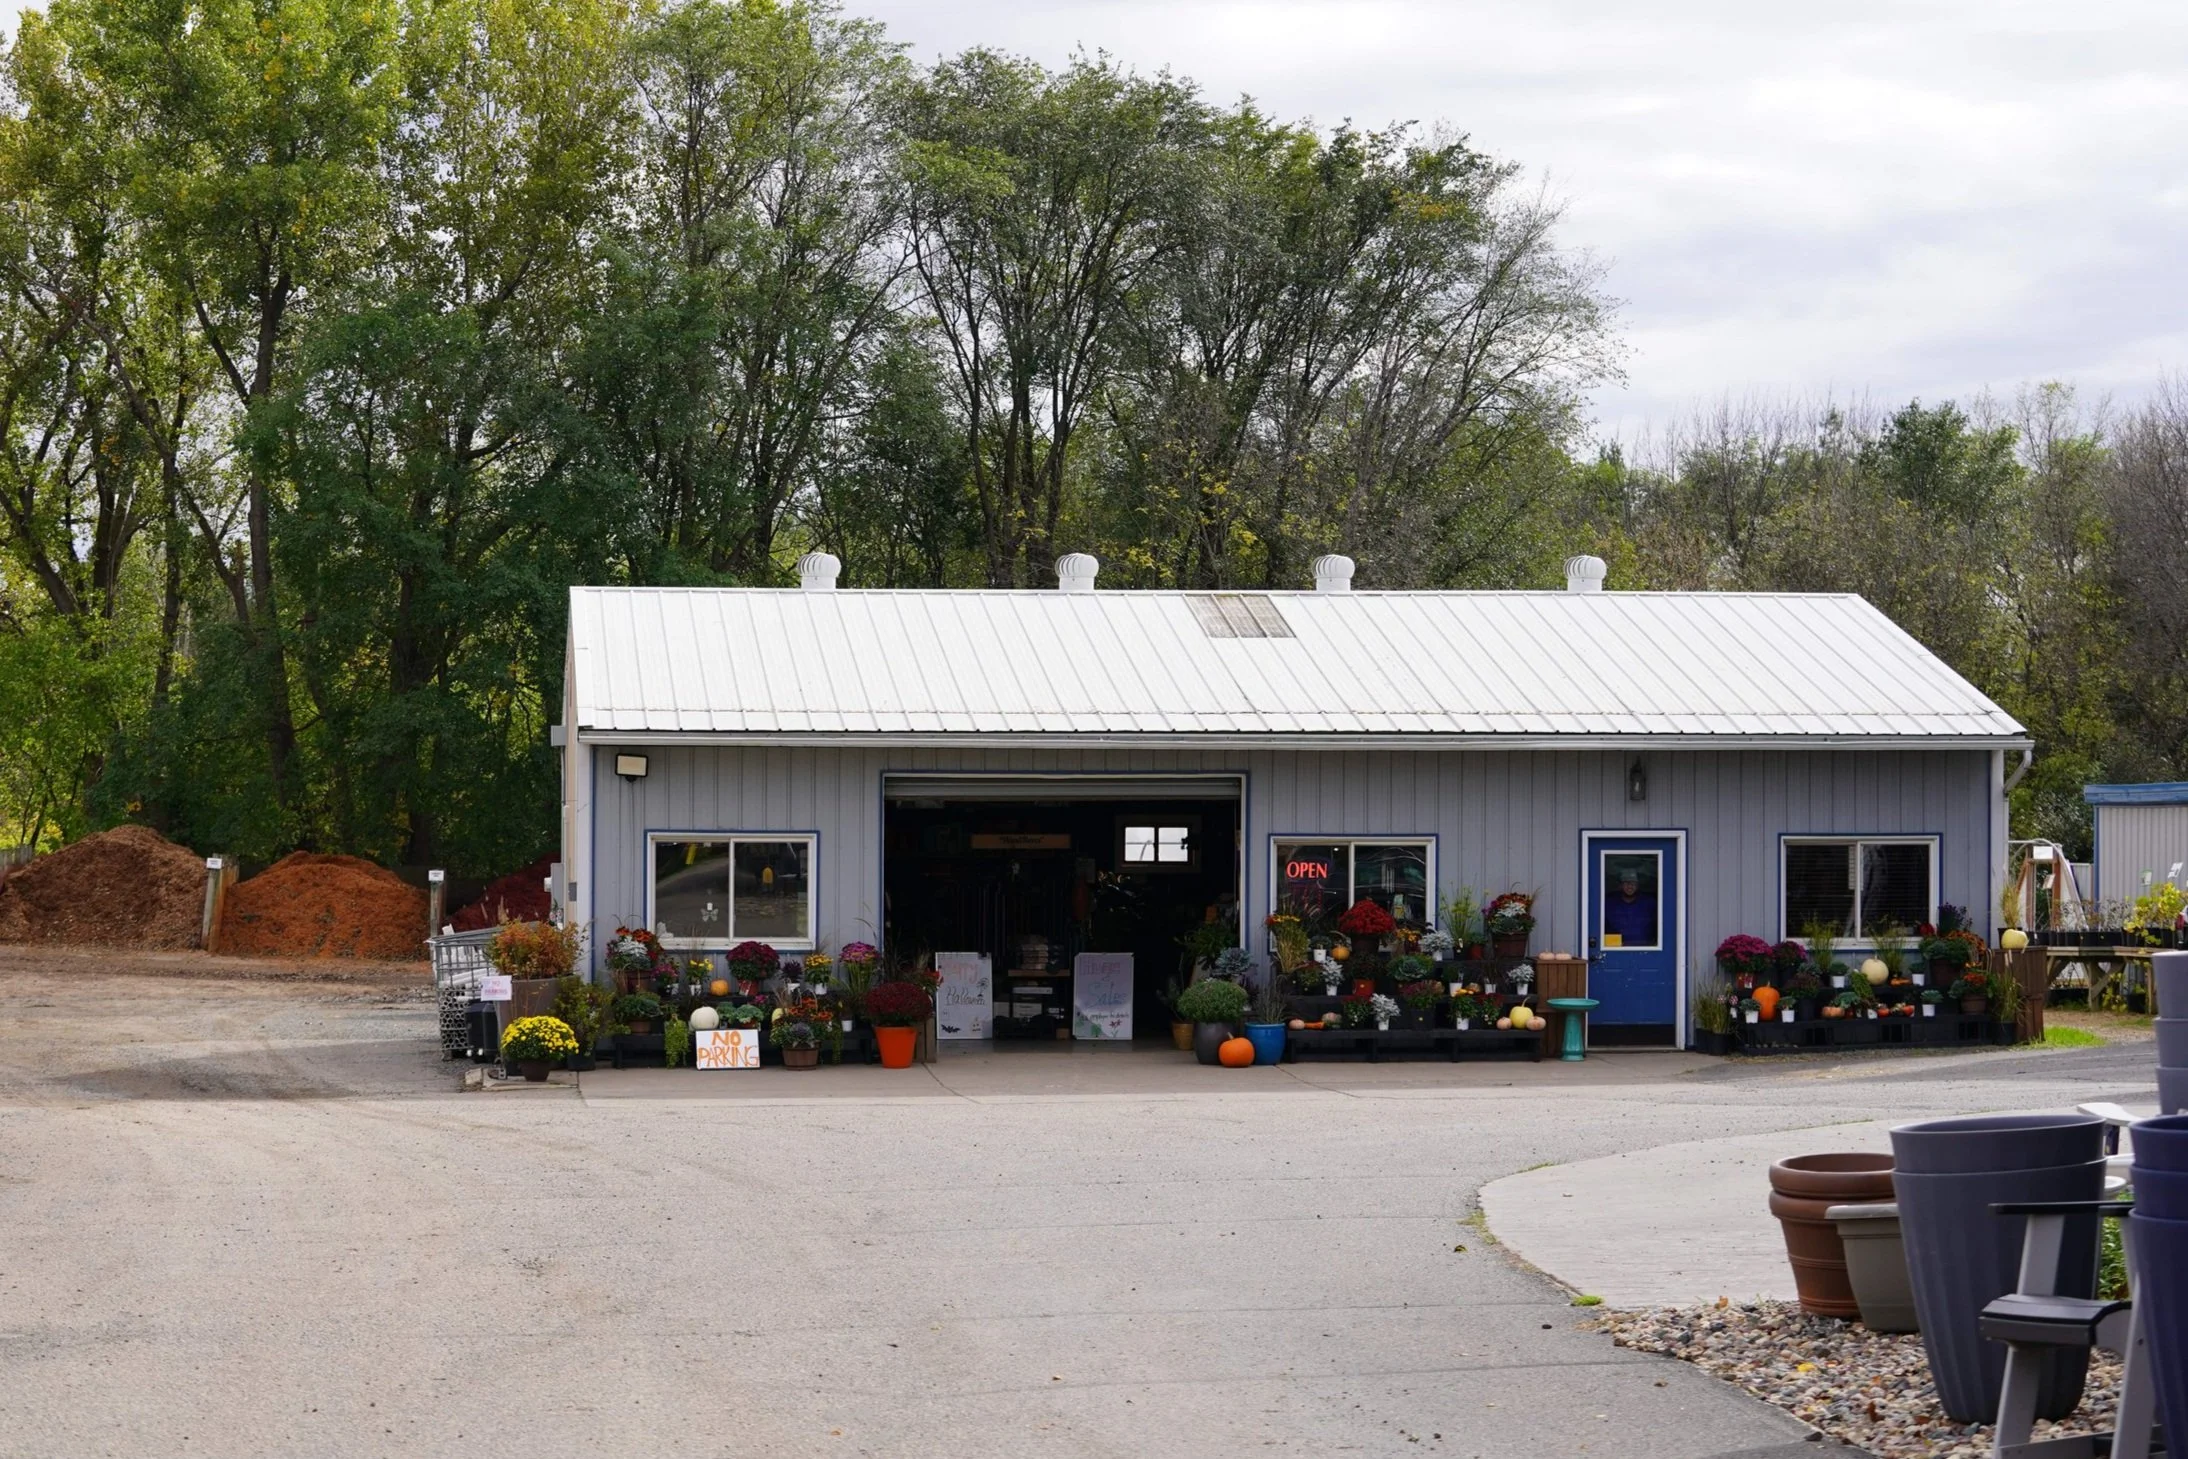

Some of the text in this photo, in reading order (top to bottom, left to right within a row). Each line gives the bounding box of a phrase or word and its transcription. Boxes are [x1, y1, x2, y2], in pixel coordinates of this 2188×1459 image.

[1286, 860, 1328, 879] OPEN
[711, 1030, 742, 1047] NO
[698, 1045, 760, 1067] PARKING
